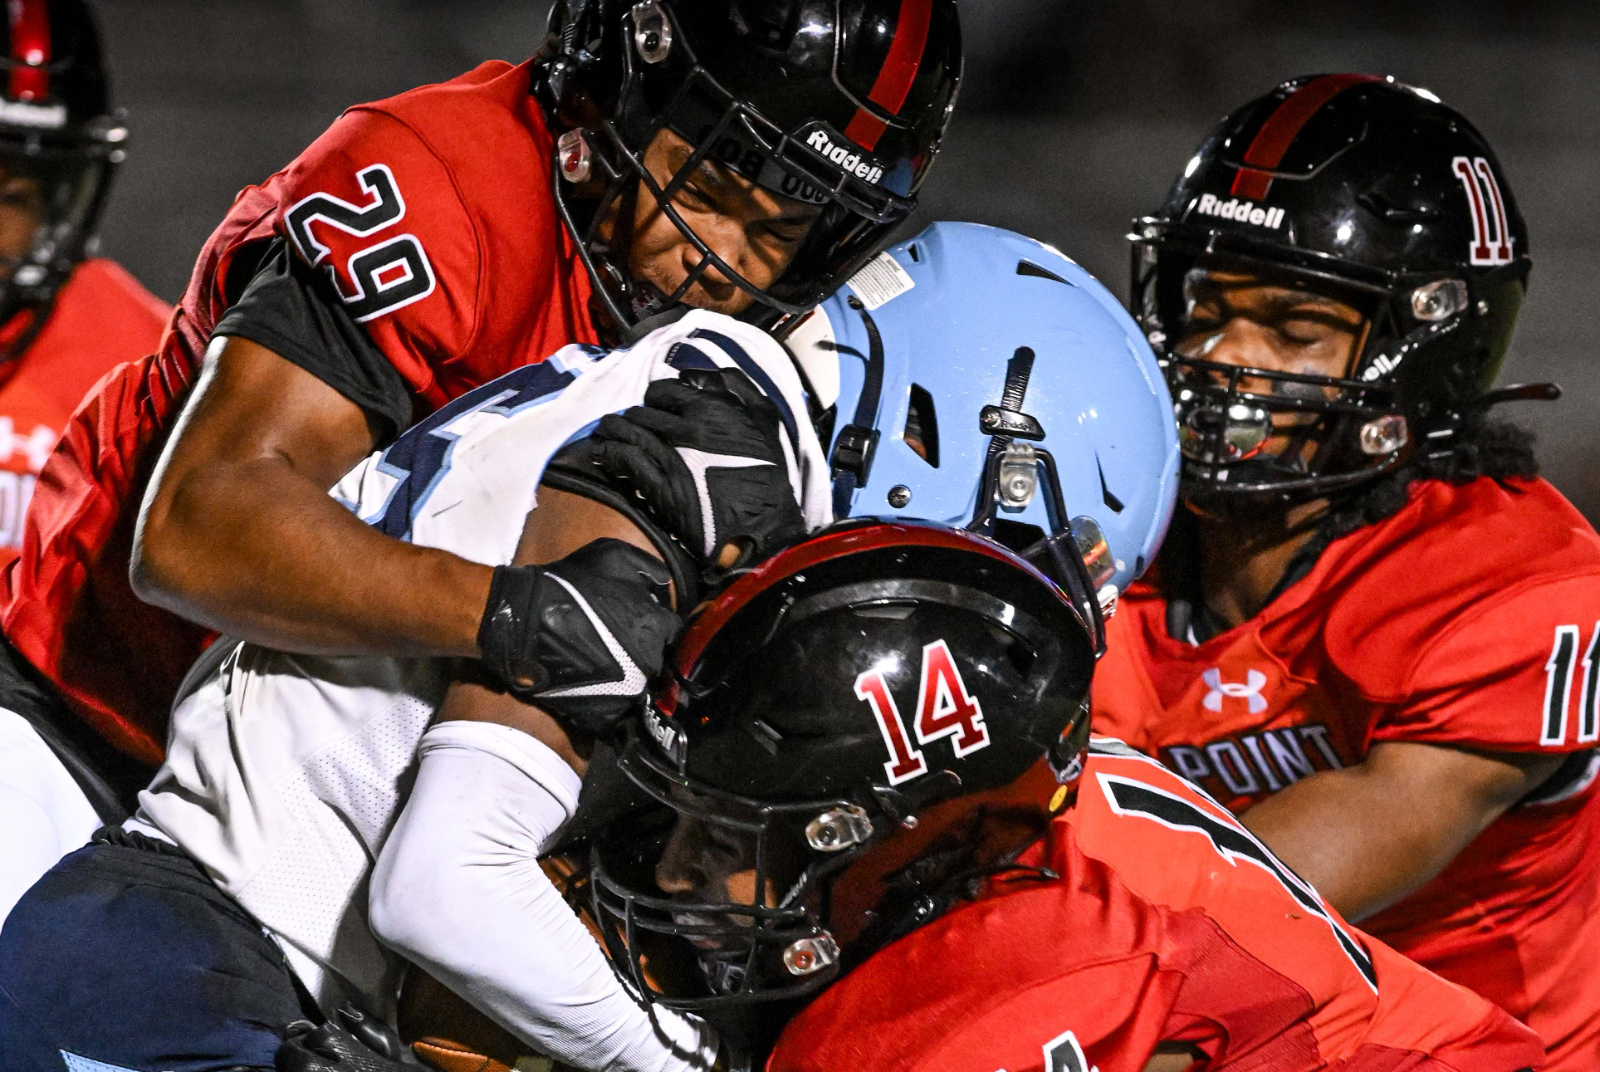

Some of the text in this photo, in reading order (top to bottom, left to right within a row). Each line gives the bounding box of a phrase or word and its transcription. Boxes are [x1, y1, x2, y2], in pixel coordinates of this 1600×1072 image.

[806, 129, 884, 184] Riddell
[1198, 193, 1285, 229] Riddell
[1452, 156, 1513, 266] 11
[284, 163, 436, 323] 29
[853, 638, 991, 786] 14
[1540, 620, 1600, 746] 11
[1166, 733, 1344, 796] POINT
